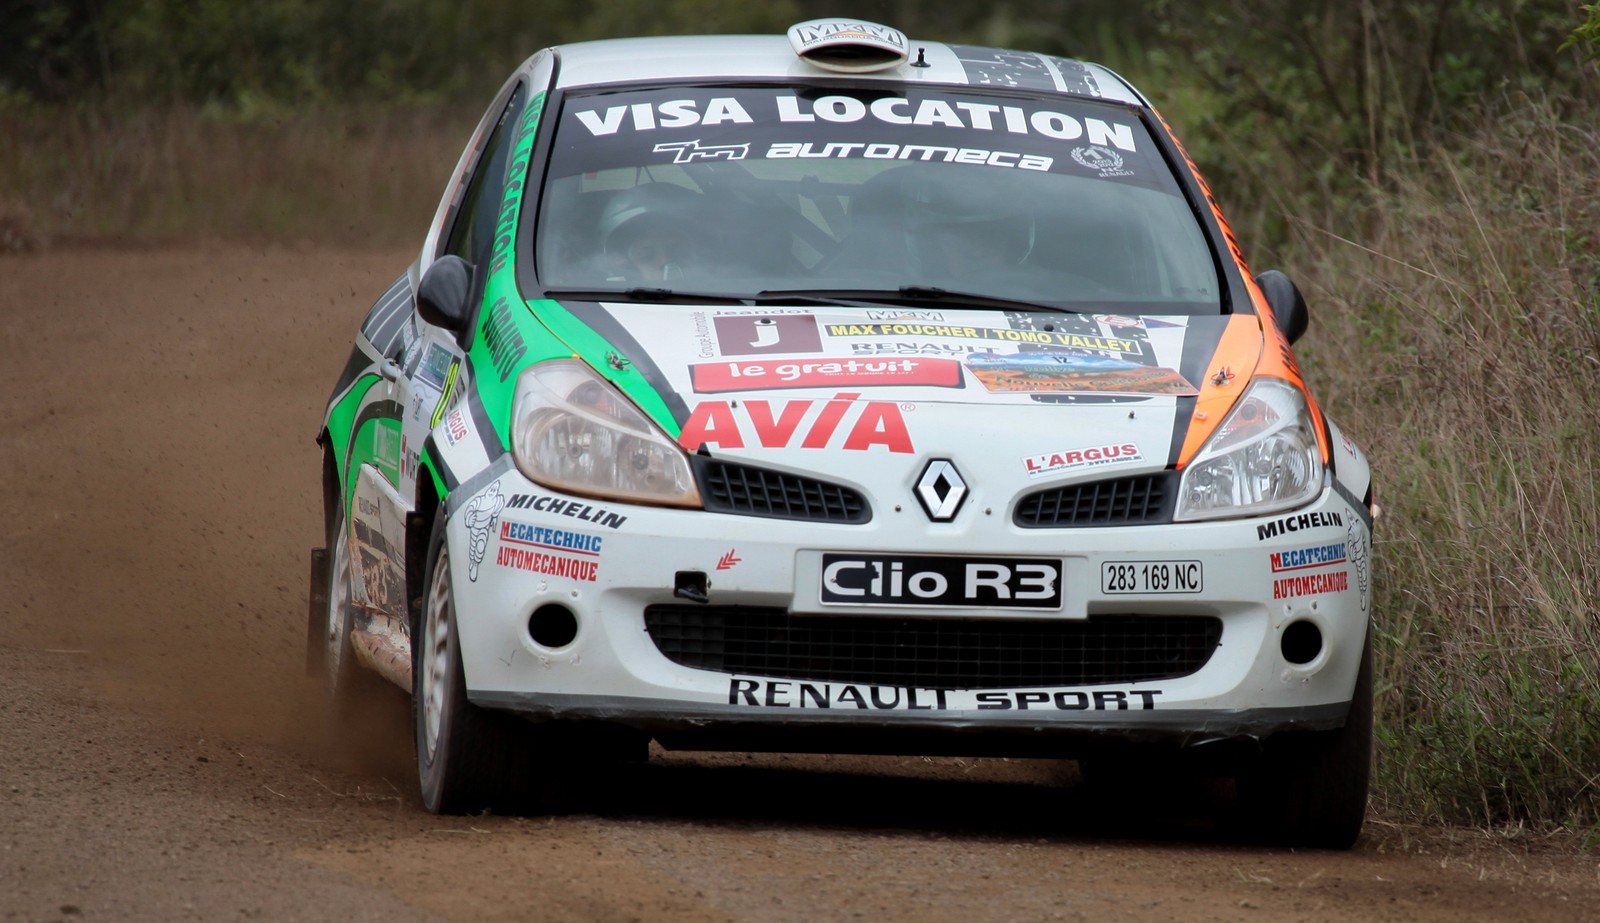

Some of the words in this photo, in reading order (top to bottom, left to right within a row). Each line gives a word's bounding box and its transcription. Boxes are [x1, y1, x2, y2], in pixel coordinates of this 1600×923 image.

[797, 24, 904, 46] MKM
[574, 97, 754, 136] VISA
[775, 95, 1137, 152] LOCATION
[765, 142, 1054, 172] automeca
[866, 310, 945, 322] MKM
[830, 325, 877, 336] MAX
[881, 325, 980, 338] FOUCHER
[992, 329, 1052, 344] TOMO
[1057, 334, 1133, 352] VALLEY
[851, 342, 1000, 354] RENAULT
[729, 362, 767, 377] le
[775, 360, 919, 381] gratuit
[1026, 444, 1137, 471] L'ARGUS
[505, 493, 628, 530] MICHELIN
[1256, 511, 1343, 541] MICHELIN
[500, 520, 603, 553] MECATECHNIC
[496, 545, 598, 582] AUTOMECANIQUE
[1270, 542, 1347, 570] MECATECHNIC
[822, 559, 948, 599] Clio
[964, 563, 1059, 600] R3
[1107, 565, 1136, 591] 283
[1141, 565, 1170, 590] 169
[1175, 563, 1199, 590] NC
[1273, 571, 1348, 600] AUTOMECANIQUE
[728, 677, 956, 710] RENAULT
[975, 688, 1164, 711] SPORT
